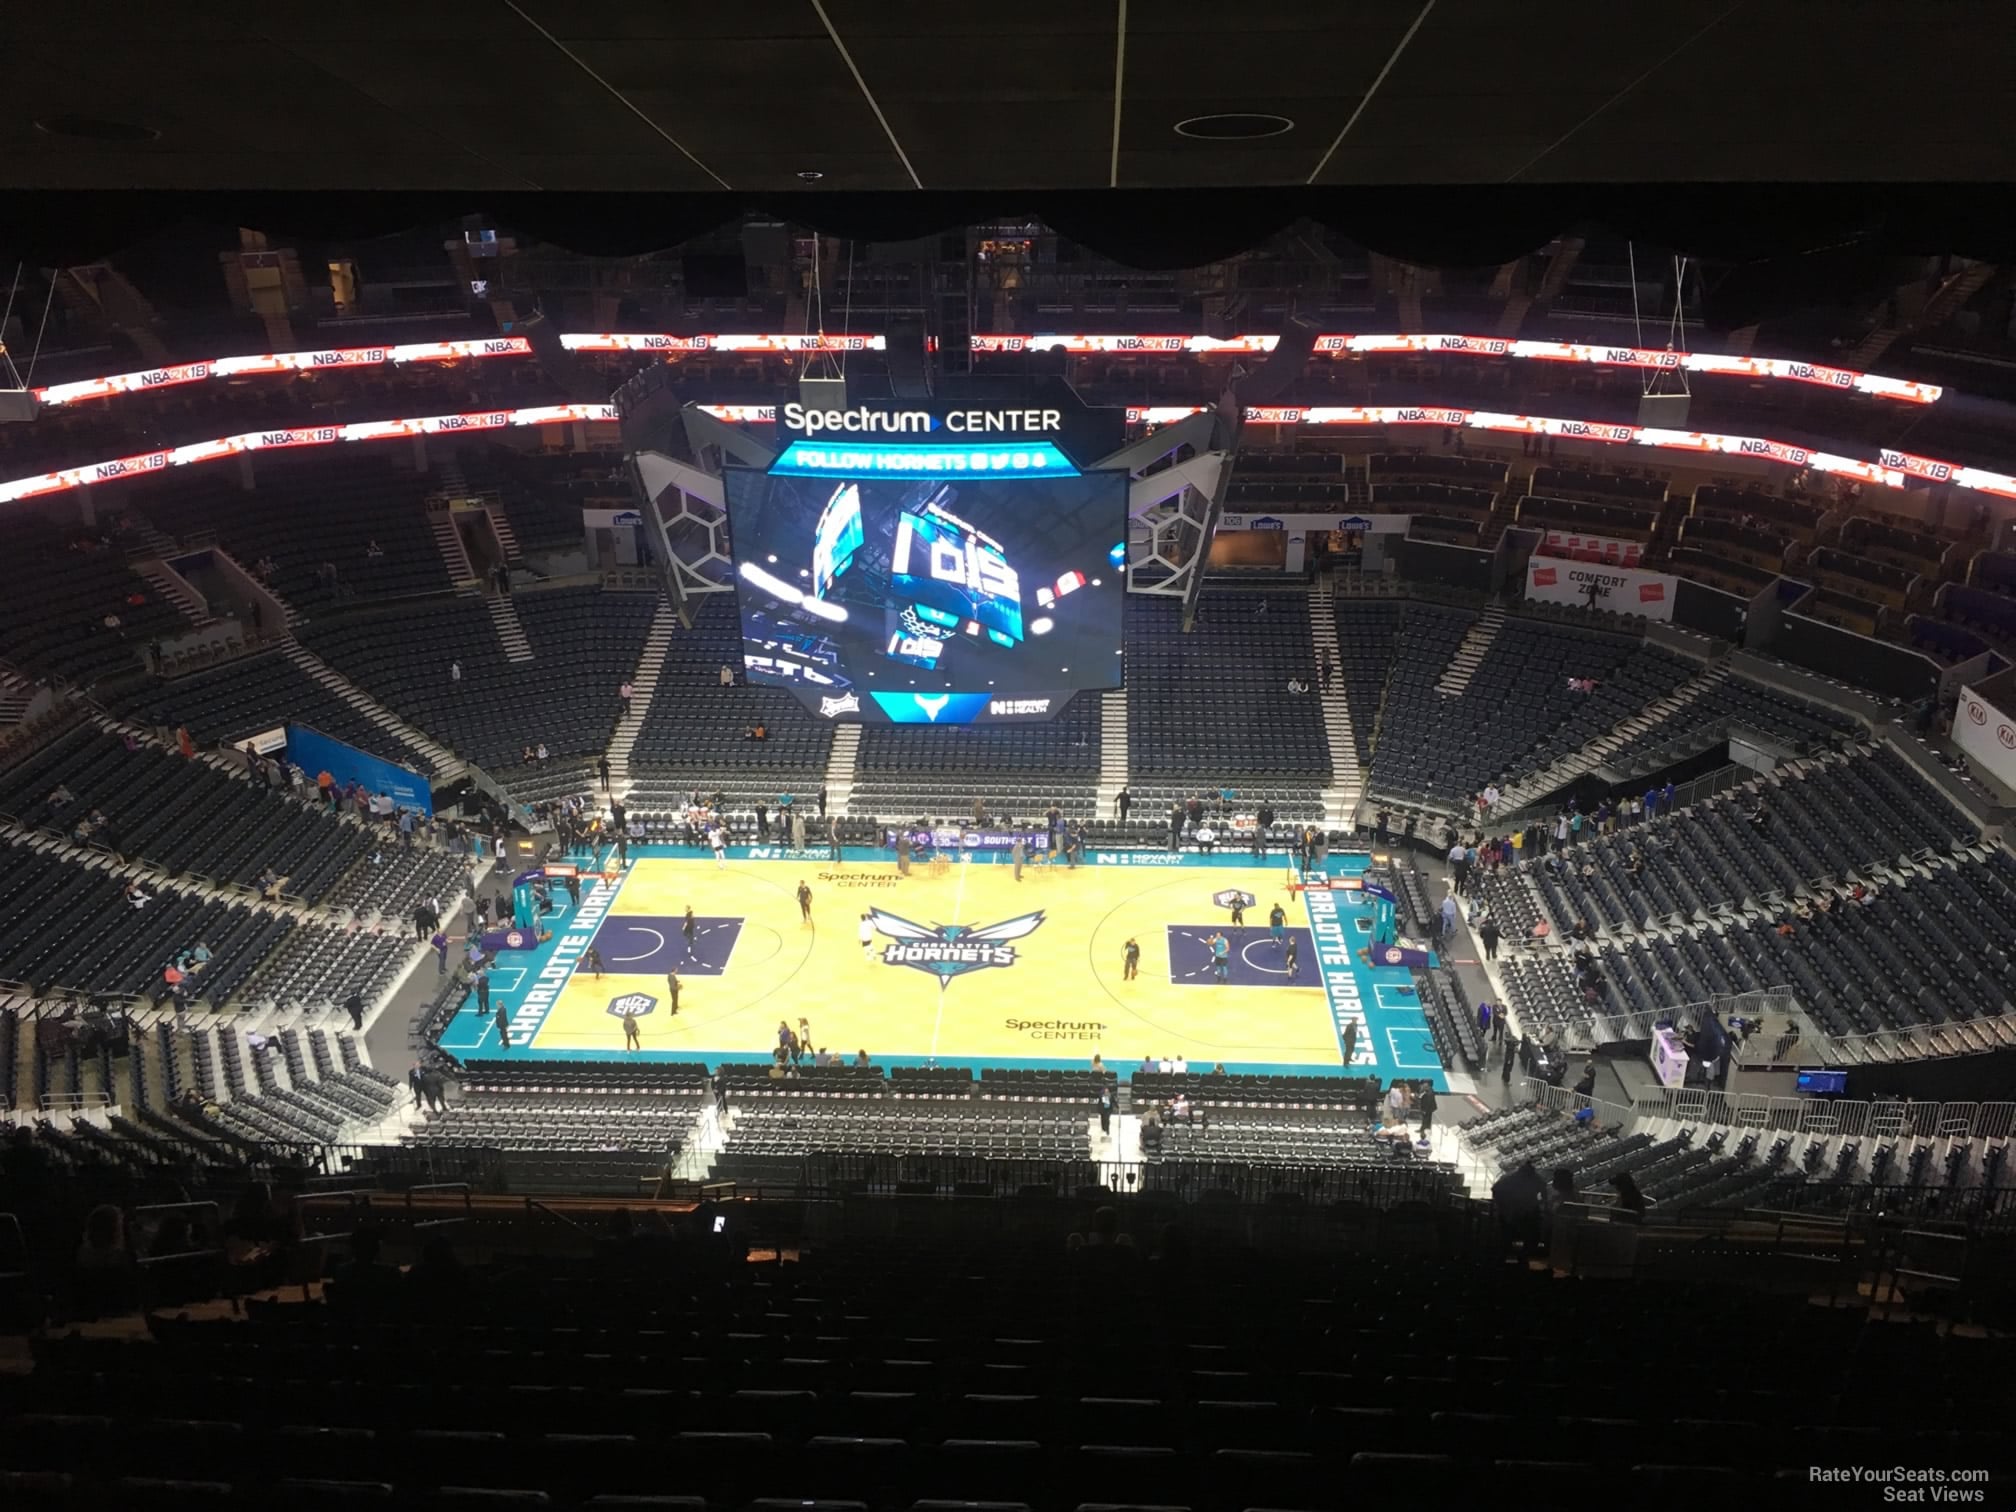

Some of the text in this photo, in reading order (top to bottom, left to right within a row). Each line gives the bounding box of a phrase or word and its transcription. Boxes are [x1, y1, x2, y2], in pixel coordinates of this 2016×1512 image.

[784, 403, 1061, 436] Spectrum CENTER
[797, 450, 967, 471] FOLLOW HORNETS
[1568, 570, 1628, 588] COMFORT
[1971, 704, 1984, 723] KIA
[2001, 727, 2014, 746] KIA
[818, 872, 899, 881] Spectrum
[885, 945, 1014, 964] HORNETS
[1006, 1018, 1102, 1031] Spectrum
[1031, 1031, 1102, 1040] CENTER
